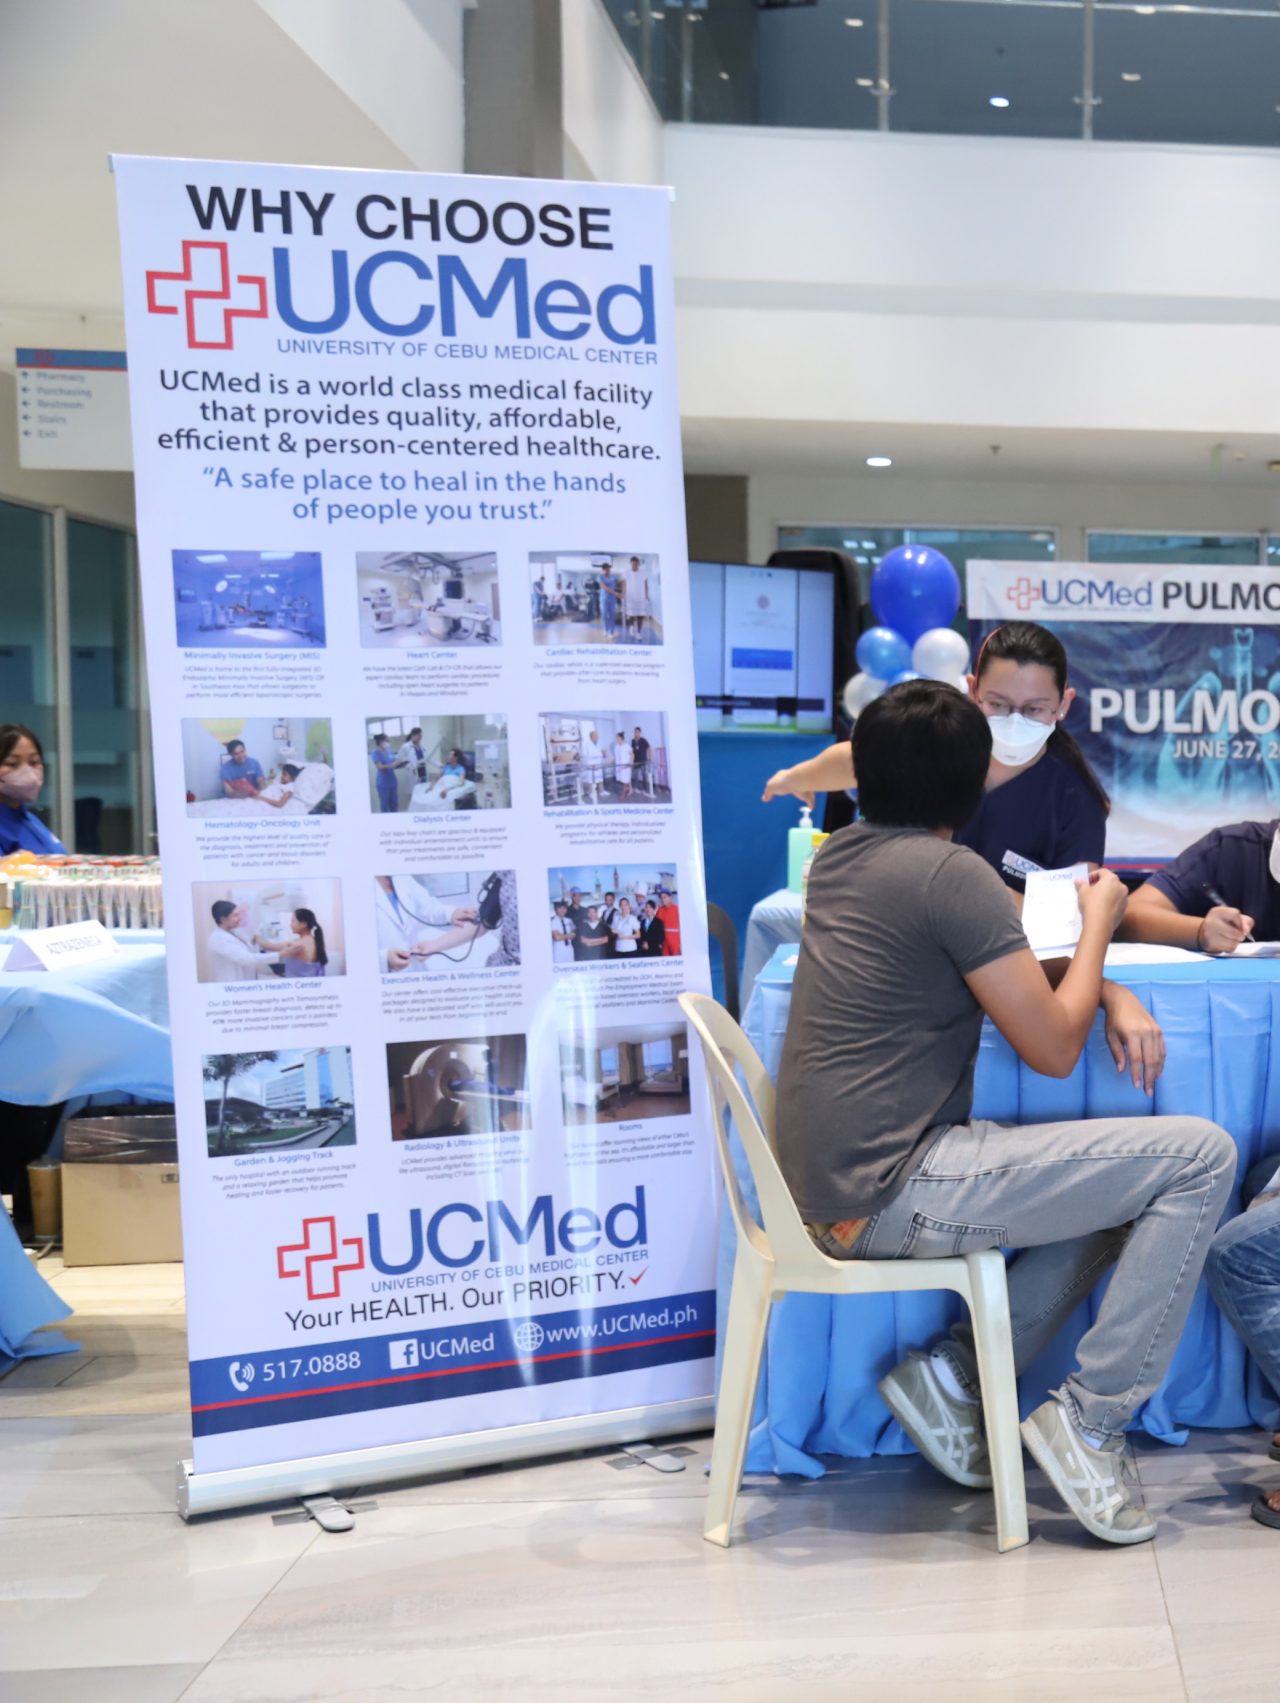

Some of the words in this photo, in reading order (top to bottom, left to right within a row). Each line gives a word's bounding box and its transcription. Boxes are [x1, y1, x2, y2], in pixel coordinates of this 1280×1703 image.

[186, 185, 335, 235] WHY
[356, 195, 613, 250] CHOOSE
[273, 247, 657, 345] UCMed
[277, 338, 396, 357] UNIVERSITY
[402, 341, 428, 357] OF
[435, 342, 487, 359] CEBU
[494, 345, 579, 362] MEDICAL
[585, 348, 657, 366] CENTER
[159, 370, 261, 394] UCMed
[269, 373, 289, 395] is
[296, 378, 311, 395] a
[318, 375, 394, 398] world
[401, 376, 462, 400] class
[469, 377, 566, 401] medical
[573, 380, 653, 409] facility
[200, 401, 256, 423] that
[265, 402, 379, 434] provides
[386, 408, 482, 433] quality,
[489, 409, 622, 433] affordable,
[158, 430, 270, 453] efficient
[278, 432, 297, 453] &
[305, 434, 518, 462] person-centered
[526, 437, 660, 461] healthcare.
[240, 468, 295, 490] safe
[303, 470, 373, 499] place
[381, 473, 407, 492] to
[414, 471, 468, 493] heal
[476, 472, 496, 493] in
[504, 471, 546, 493] the
[553, 472, 626, 494] hands
[292, 498, 319, 520] of
[327, 499, 417, 529] people
[425, 503, 472, 525] you
[1042, 579, 1152, 606] UCMed
[184, 652, 226, 661] Minimally
[229, 652, 262, 660] Invasive
[265, 652, 297, 661] Surgery
[407, 651, 429, 659] Heart
[431, 650, 457, 659] Center
[546, 648, 574, 657] Cardiac
[576, 648, 628, 657] Rehabilitation
[630, 649, 652, 657] Center
[1090, 688, 1280, 734] PULMO
[1173, 740, 1227, 759] JUNE
[1233, 741, 1263, 761] 27,
[414, 815, 443, 824] Dialysis
[446, 814, 471, 822] Center
[544, 809, 591, 817] Rehabilitation
[601, 808, 621, 817] Sports
[623, 807, 654, 816] Medicine
[656, 807, 674, 815] Center
[382, 975, 419, 985] Executive
[422, 974, 449, 983] Health
[458, 971, 492, 980] Wellness
[494, 970, 520, 978] Center
[553, 964, 586, 974] Overseas
[588, 962, 619, 972] Workers
[628, 960, 660, 968] Seafarers
[663, 959, 684, 967] Center
[268, 981, 292, 991] Health
[295, 980, 322, 990] Center
[619, 1123, 642, 1131] Rooms
[234, 1157, 266, 1167] Garden
[277, 1153, 310, 1165] Jogging
[313, 1151, 333, 1159] Track
[405, 1141, 444, 1153] Radiology
[367, 1186, 648, 1275] UCMed
[371, 1274, 457, 1293] UNIVERSITY
[461, 1269, 480, 1281] OF
[484, 1264, 525, 1279] CEBU
[529, 1258, 591, 1274] MEDICAL
[596, 1249, 649, 1267] CENTER
[285, 1308, 343, 1332] Your
[350, 1293, 454, 1323] HEALTH.
[462, 1288, 504, 1308] Our
[512, 1270, 626, 1304] PRIORITY.
[263, 1351, 361, 1382] 517.0888
[421, 1334, 495, 1361] UCMed
[546, 1306, 698, 1343] www.UCMed.ph
